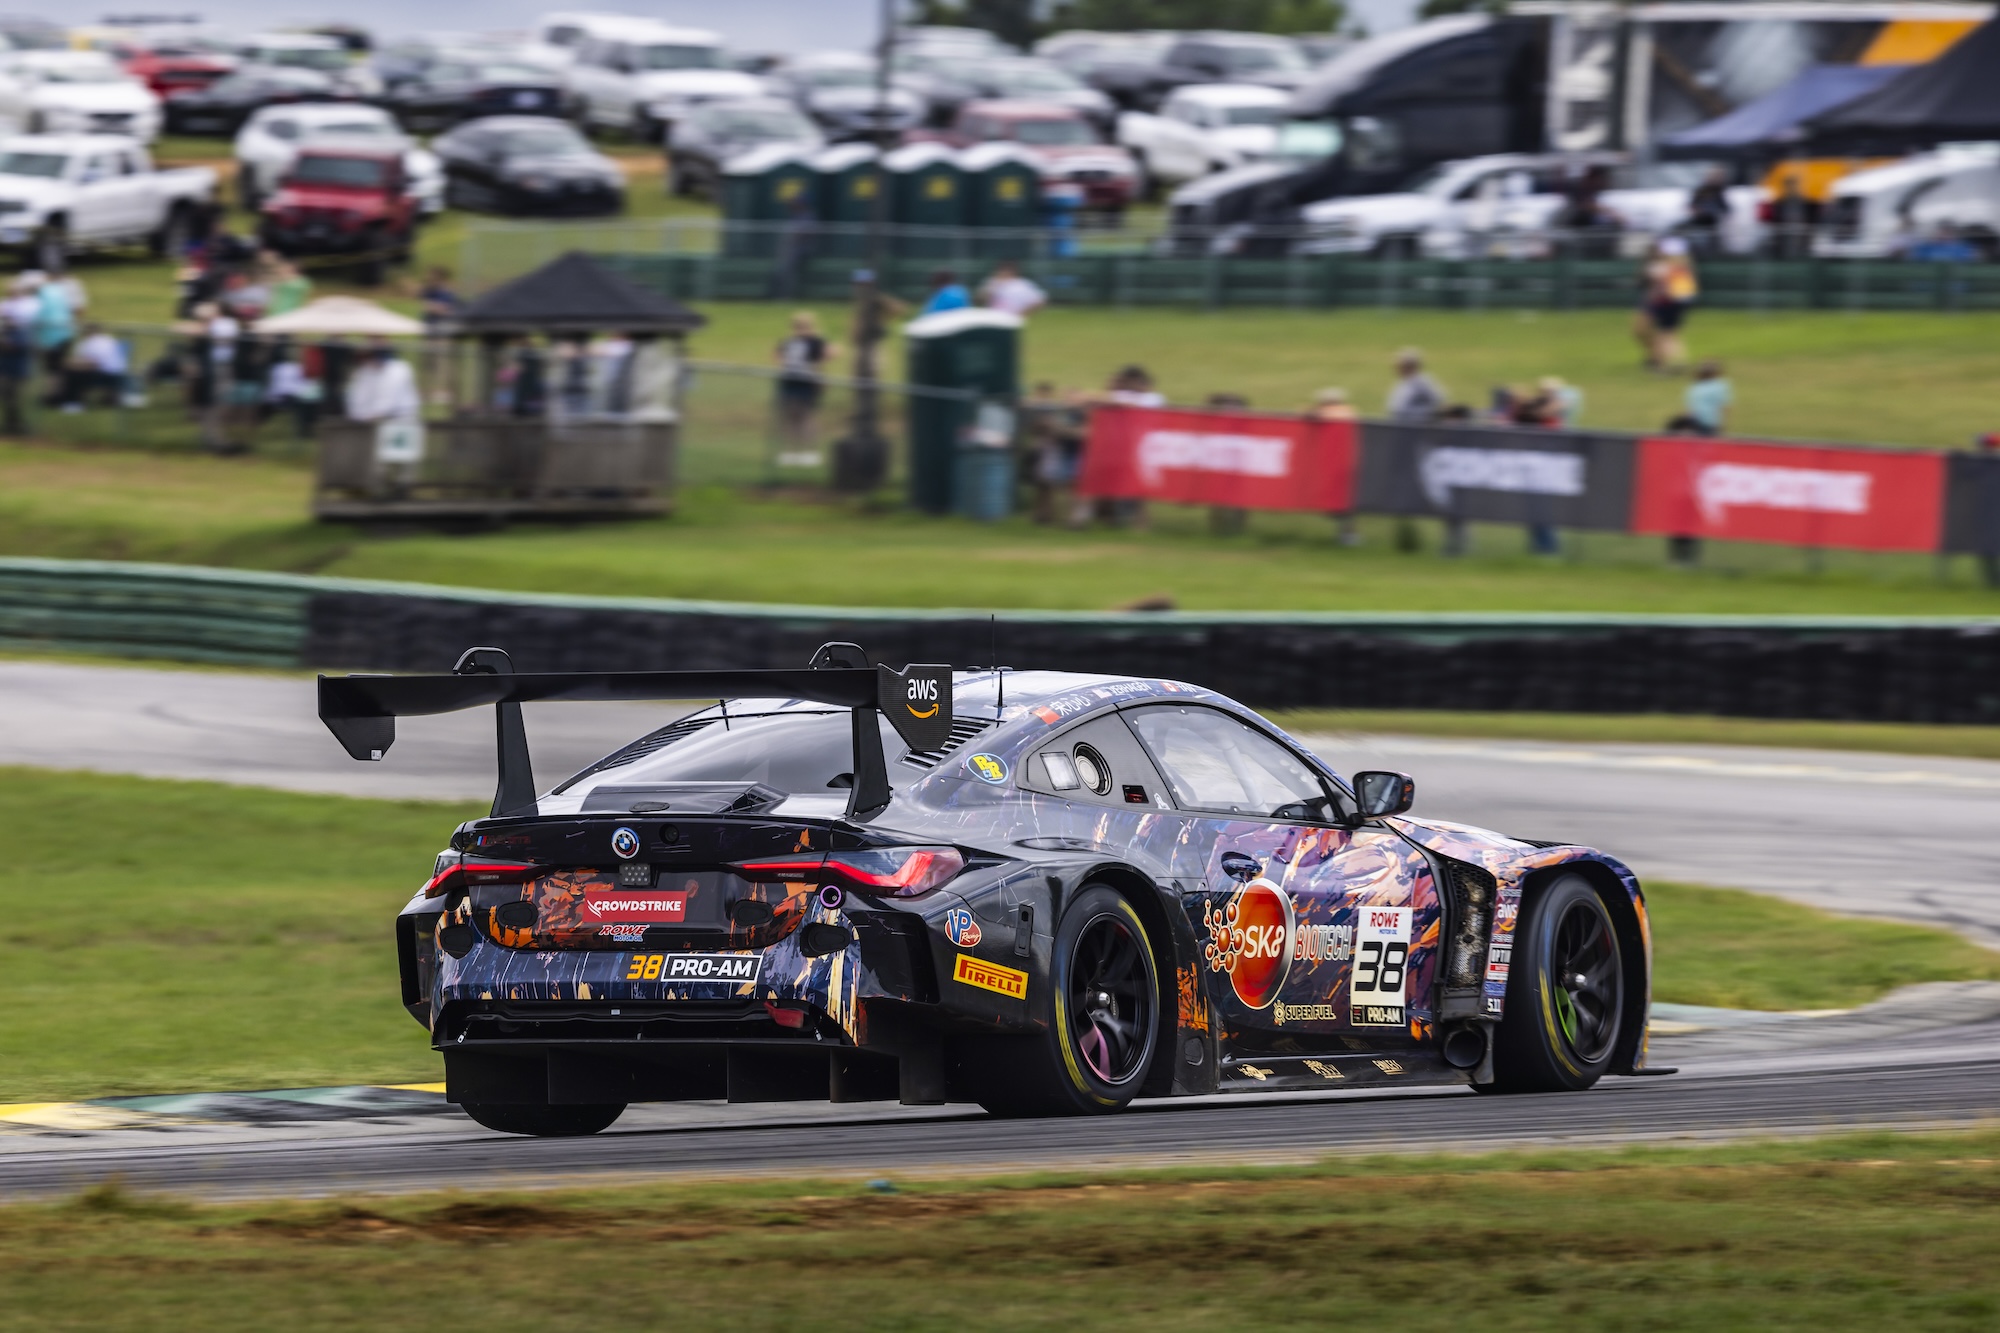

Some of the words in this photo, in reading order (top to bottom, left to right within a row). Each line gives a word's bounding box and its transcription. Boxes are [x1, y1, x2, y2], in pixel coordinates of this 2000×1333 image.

[907, 678, 938, 701] aws
[594, 900, 682, 912] CROWDSTRIKE
[600, 924, 648, 936] ROWE
[947, 909, 972, 945] VP
[1370, 912, 1399, 928] ROWE
[961, 931, 980, 942] Racing
[1294, 924, 1352, 960] BIOTECH
[626, 954, 664, 980] 38
[670, 959, 753, 978] PRO-AM
[959, 959, 1022, 994] PIRELLI
[1355, 941, 1408, 992] 38
[1368, 1006, 1400, 1023] PRO-AM
